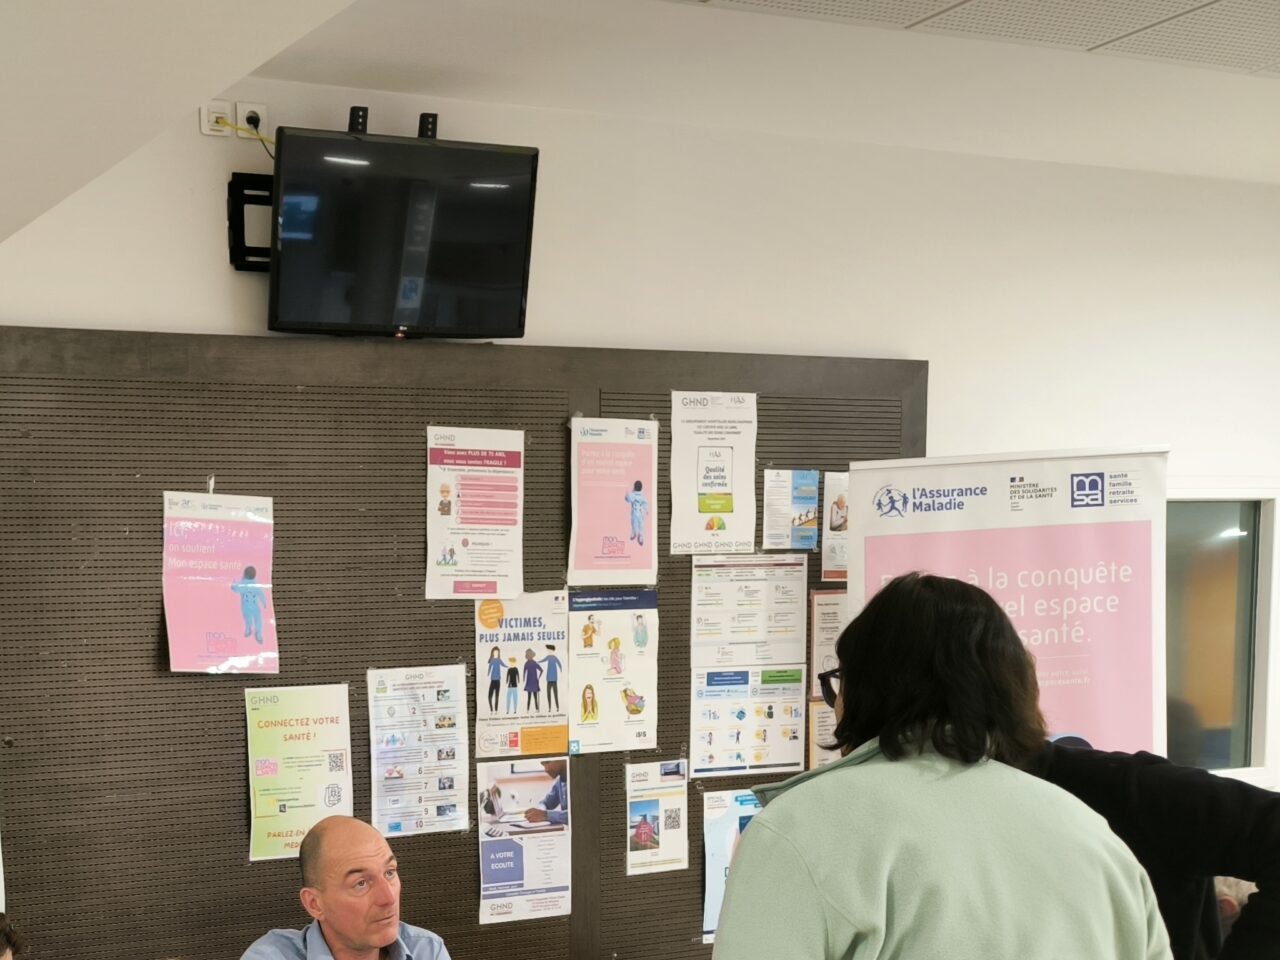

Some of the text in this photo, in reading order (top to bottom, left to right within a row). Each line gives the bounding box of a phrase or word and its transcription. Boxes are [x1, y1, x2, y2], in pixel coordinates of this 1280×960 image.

[682, 397, 709, 407] GHND
[1109, 480, 1132, 488] famille
[912, 499, 966, 513] Maladie
[1108, 497, 1138, 505] services
[988, 566, 1009, 590] la
[1017, 561, 1133, 591] conquête
[1034, 594, 1121, 620] espace
[479, 630, 565, 643] PLUS JAMAIS SEULES
[257, 716, 340, 729] CONNECTEZ VOTRE
